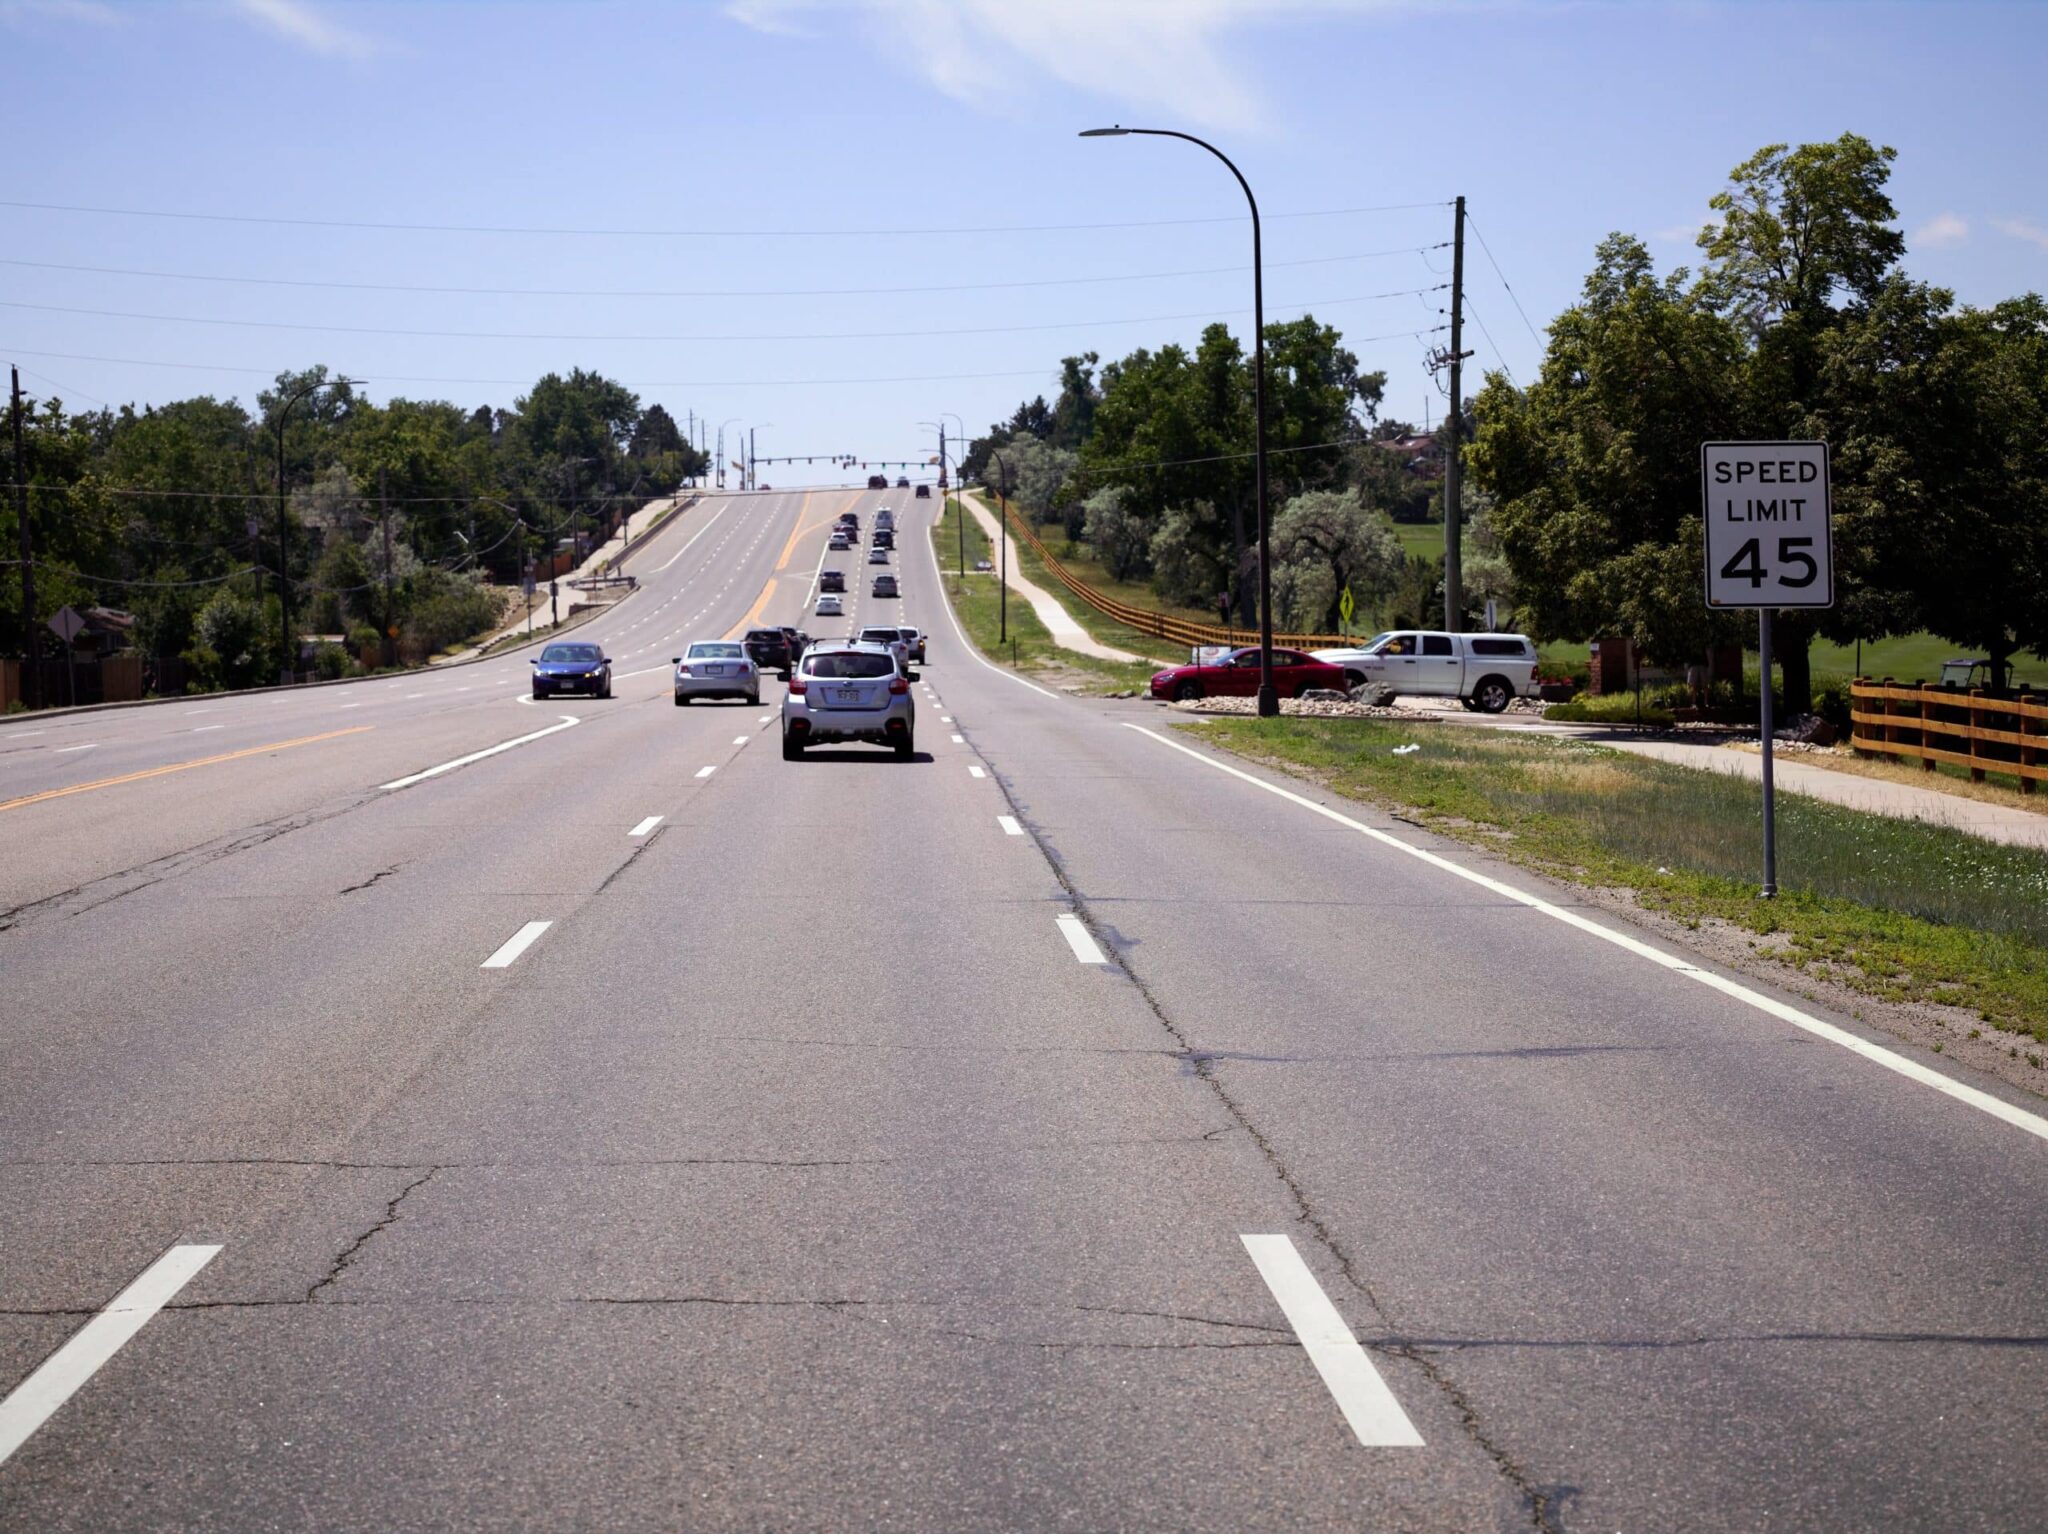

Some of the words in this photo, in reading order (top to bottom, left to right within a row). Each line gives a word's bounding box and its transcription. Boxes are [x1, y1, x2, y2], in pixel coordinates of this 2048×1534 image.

[1715, 461, 1818, 484] SPEED
[1727, 499, 1807, 522] LIMIT
[1720, 537, 1818, 588] 45
